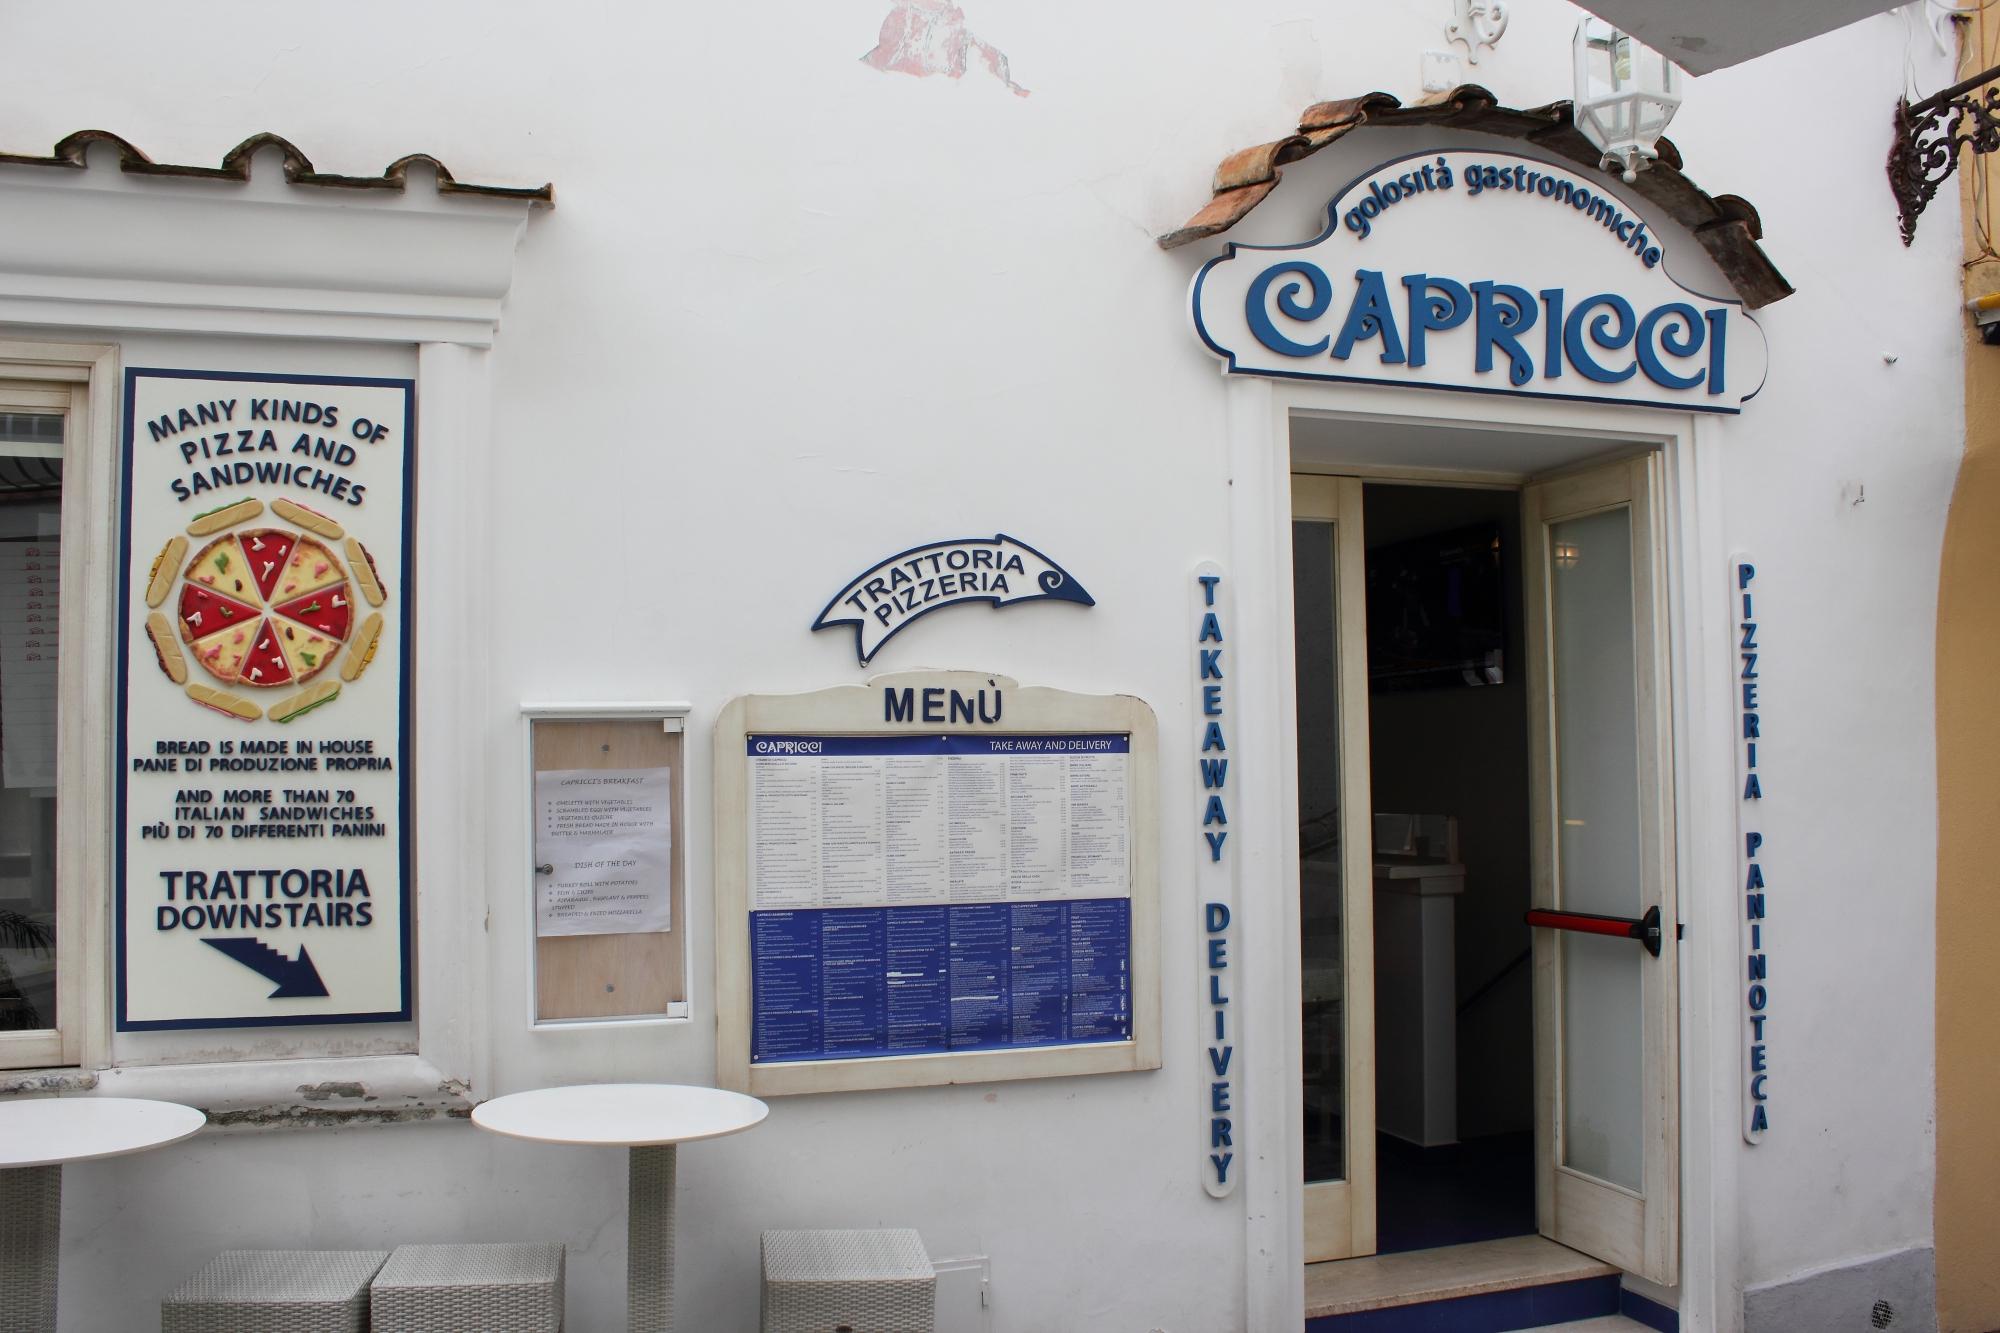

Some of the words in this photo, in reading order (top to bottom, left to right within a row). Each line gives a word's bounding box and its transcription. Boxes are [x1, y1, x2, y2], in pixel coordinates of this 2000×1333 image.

[1344, 157, 1454, 240] golosità
[1464, 163, 1663, 270] gastronomiche
[1245, 261, 1728, 395] CAPRICCI
[147, 398, 237, 442] MANY
[250, 398, 339, 428] KINDS
[352, 417, 389, 444] OF
[180, 429, 278, 464] PIZZA
[291, 433, 357, 466] AND
[171, 462, 366, 506] SANDWICHES
[845, 549, 1025, 613] TRATTORIA
[873, 572, 1009, 627] PIZZERIA
[1738, 563, 1762, 800] PIZZERIA
[884, 679, 1002, 724] MENÙ
[156, 740, 211, 755] BREAD
[219, 740, 233, 754] IS
[240, 740, 289, 754] MADE
[296, 740, 313, 754] IN
[319, 740, 374, 754] HOUSE
[756, 741, 822, 755] CAPRICCI
[990, 741, 1013, 751] TAKE
[1015, 741, 1043, 750] AWAY
[1045, 741, 1067, 750] AND
[1068, 740, 1112, 750] DELIVERY
[133, 758, 177, 772] PANE
[185, 758, 202, 772] DI
[210, 757, 318, 772] PRODUZIONE
[326, 757, 392, 771] PROPRIA
[603, 777, 645, 785] BREAKFAST
[174, 806, 245, 821] ITALIAN
[259, 806, 375, 820] SANDWICHES
[175, 789, 213, 803] AND
[223, 789, 272, 803] MORE
[282, 789, 329, 803] THAN
[336, 789, 355, 803] 70
[141, 821, 170, 839] PIÙ
[177, 825, 195, 839] DI
[205, 825, 223, 839] 70
[231, 824, 324, 838] DIFFERENTI
[332, 823, 385, 837] PANINI
[574, 861, 593, 869] DISH
[594, 860, 605, 868] OF
[607, 860, 620, 868] THE
[622, 859, 637, 867] DAY
[159, 868, 371, 901] TRATTORIA
[157, 901, 373, 931] DOWNSTAIRS
[1746, 832, 1768, 1131] PANINOTECA
[1205, 902, 1233, 1184] DELIVERY
